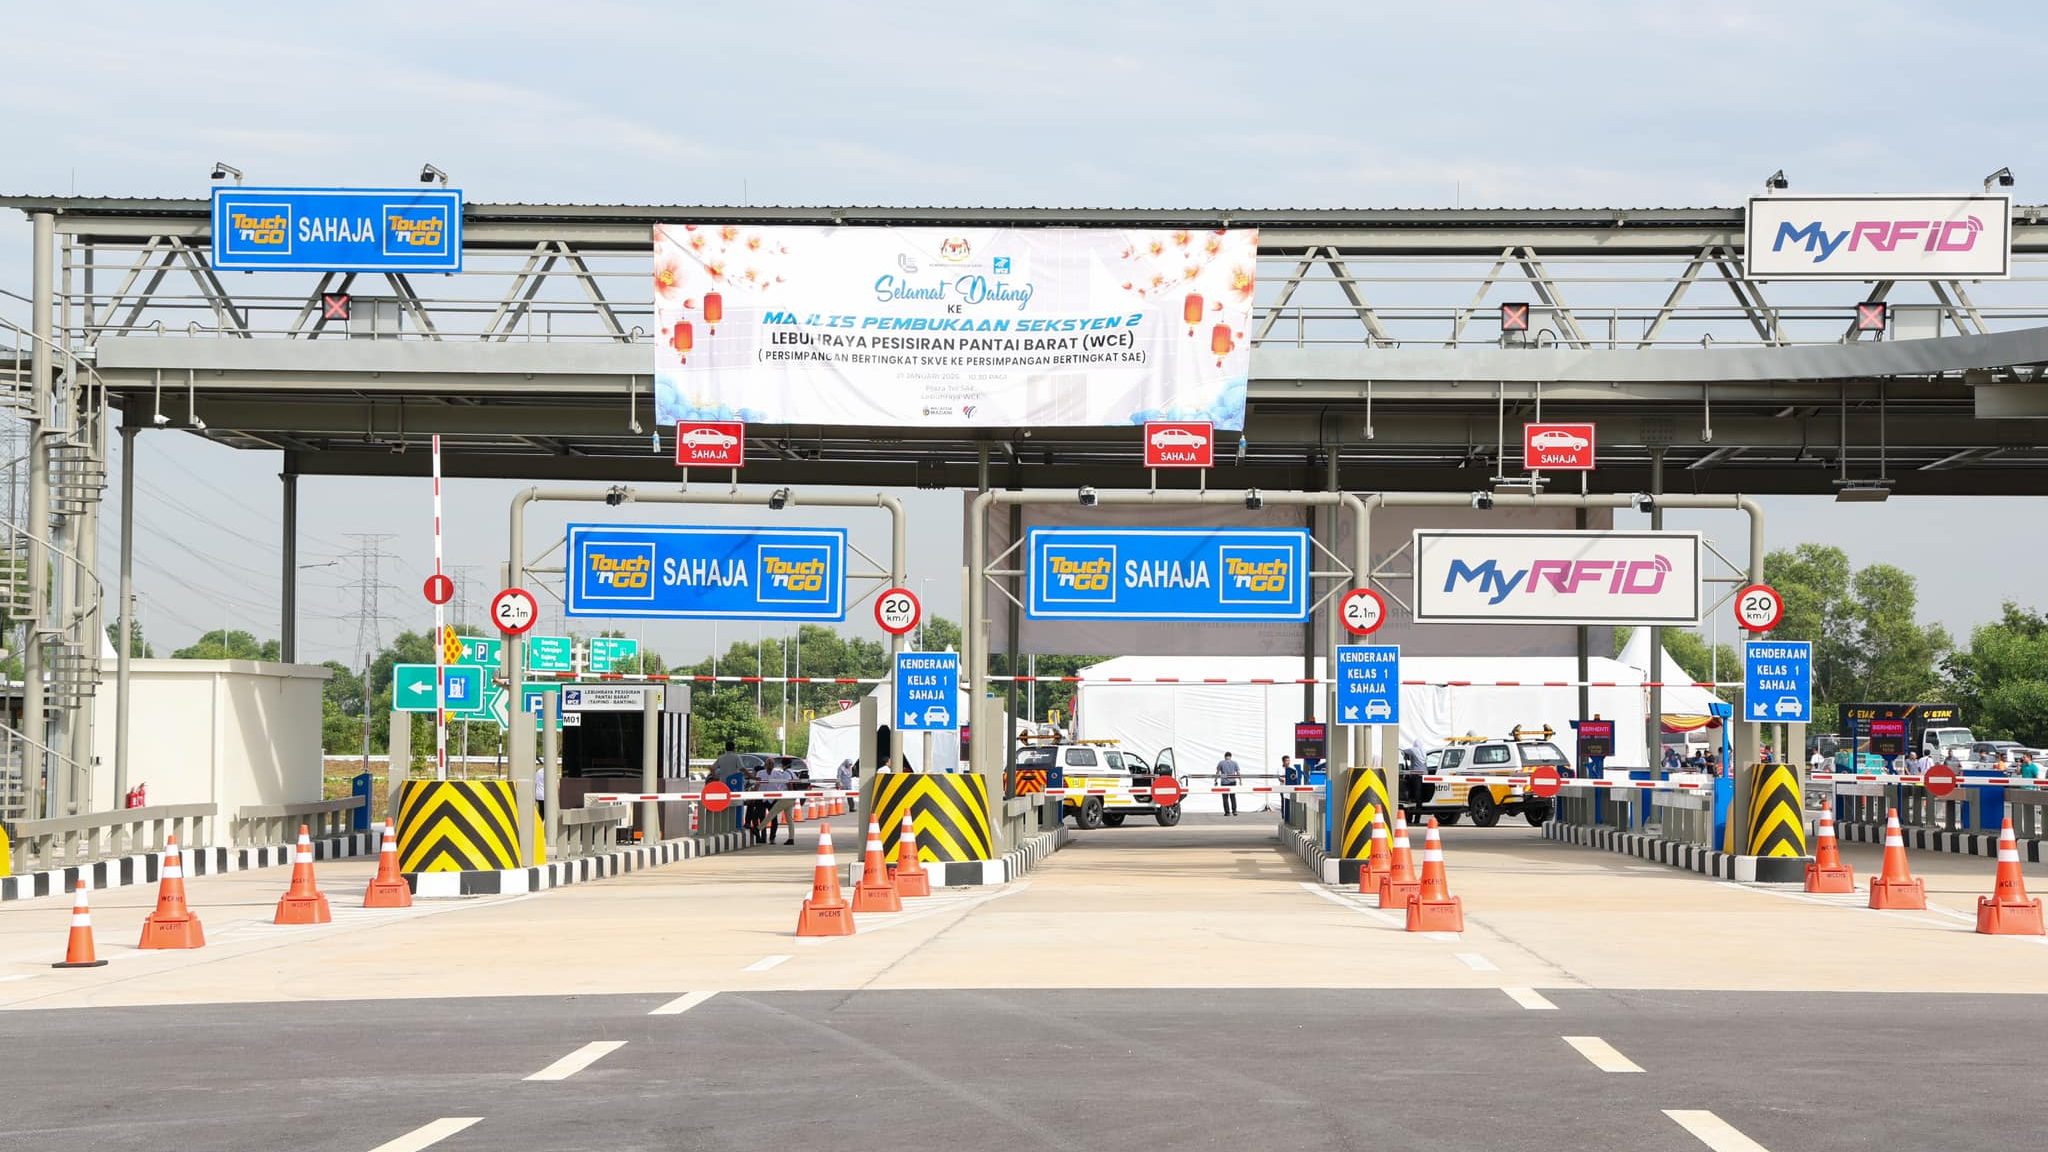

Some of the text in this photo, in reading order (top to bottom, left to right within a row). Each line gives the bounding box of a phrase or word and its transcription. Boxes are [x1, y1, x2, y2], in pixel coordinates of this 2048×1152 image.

[232, 213, 288, 229] Touch
[387, 215, 443, 231] Touch
[298, 216, 375, 243] SAHAJA
[874, 274, 1034, 311] Selamat Datang
[947, 304, 962, 314] KE
[861, 316, 1010, 332] PEMBUKAAN
[1015, 315, 1122, 332] SEKSYEN
[1126, 313, 1143, 327] 2
[871, 336, 955, 351] PESISIRAN
[959, 338, 1020, 351] PANTAI
[1024, 337, 1078, 351] BARAT
[1083, 330, 1134, 351] (WCE)
[852, 354, 918, 366] BERTINGKAT
[921, 356, 948, 366] SKVE
[951, 357, 963, 366] KE
[966, 356, 1050, 366] PERSIMPANGAN
[1053, 352, 1119, 364] BERTINGKAT
[1122, 350, 1146, 364] SAE)
[691, 450, 728, 459] SAHAJA
[1161, 452, 1197, 461] SAHAJA
[1541, 454, 1577, 464] SAHAJA
[589, 553, 650, 571] Touch
[763, 556, 825, 574] Touch
[1049, 556, 1111, 574] Touch
[1225, 557, 1288, 575] Touch
[662, 557, 748, 587] SAHAJA
[1124, 559, 1210, 588] SAHAJA
[885, 599, 910, 613] 20
[1745, 597, 1772, 611] 20
[887, 614, 909, 623] km/j
[1747, 611, 1771, 621] km/j
[477, 645, 486, 658] P
[1340, 652, 1396, 662] KENDERAAN
[1749, 648, 1807, 659] KENDERAAN
[900, 658, 955, 669] KENDERAAN
[1347, 668, 1388, 679] KELAS 1
[1757, 665, 1800, 676] KELAS 1
[907, 675, 948, 686] KELAS 1
[1759, 680, 1797, 691] SAHAJA
[1350, 683, 1386, 693] SAHAJA
[909, 690, 945, 700] SAHAJA
[563, 715, 580, 723] M01
